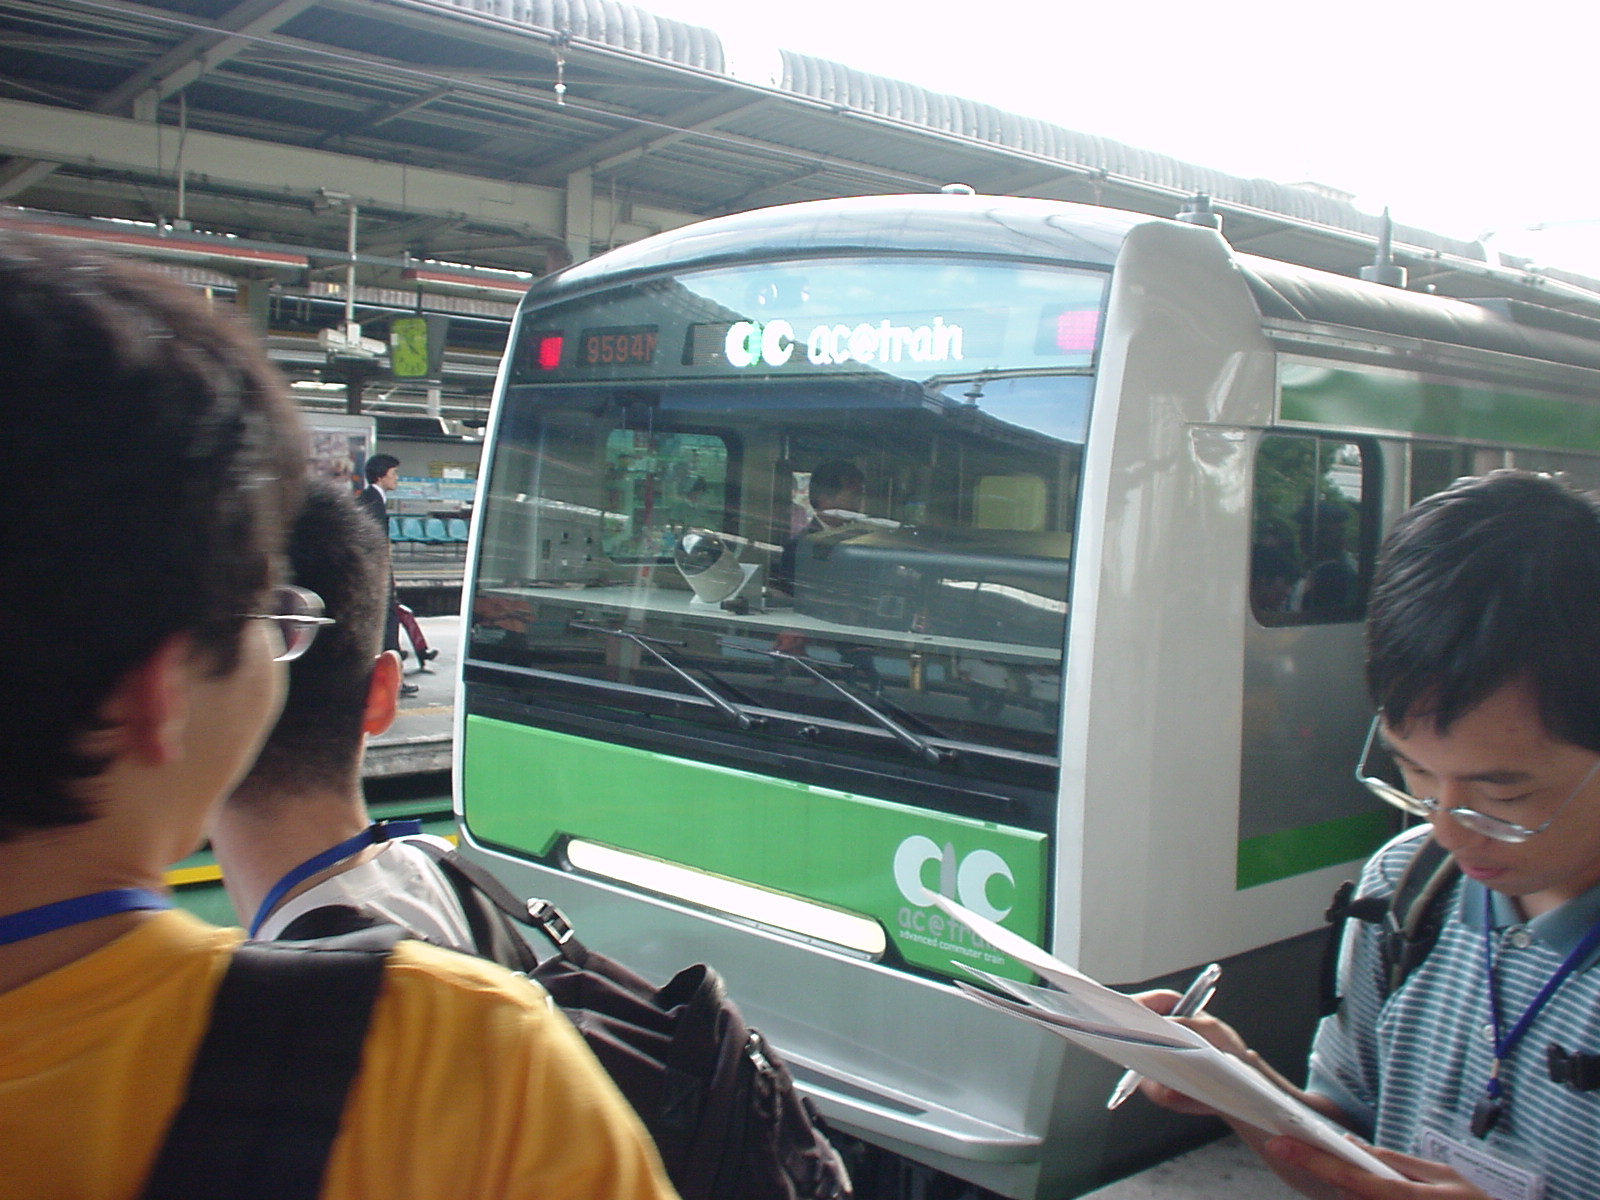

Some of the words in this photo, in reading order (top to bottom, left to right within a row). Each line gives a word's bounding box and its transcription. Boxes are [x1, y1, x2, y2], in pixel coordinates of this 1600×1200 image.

[900, 930, 938, 947] advanced
[939, 941, 982, 959] commuter
[984, 952, 1005, 965] train
